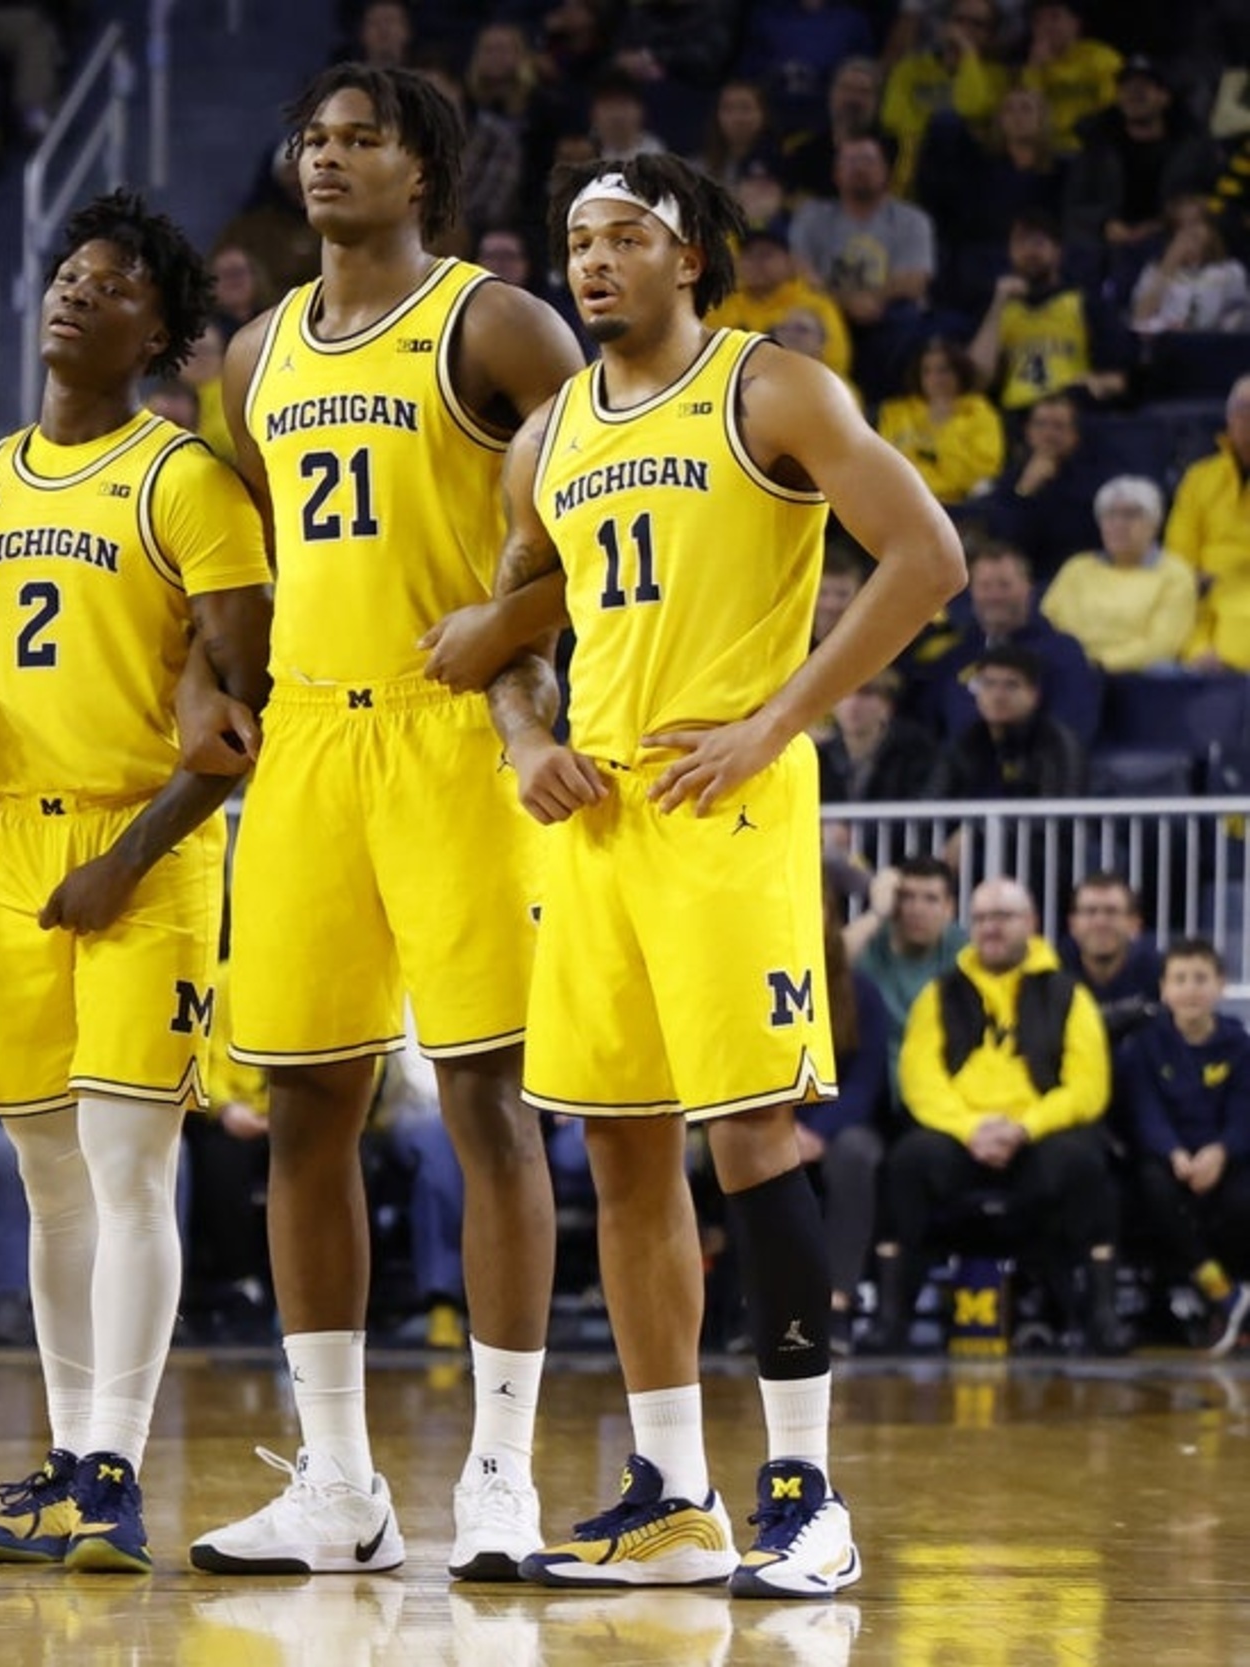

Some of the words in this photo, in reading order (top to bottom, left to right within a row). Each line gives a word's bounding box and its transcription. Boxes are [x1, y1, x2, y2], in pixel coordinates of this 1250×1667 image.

[267, 395, 418, 441] MICHIGAN
[301, 448, 378, 541] 21
[555, 457, 709, 518] MICHIGAN
[597, 513, 660, 608] 11
[17, 582, 60, 668] 2
[349, 689, 373, 709] M
[41, 798, 65, 815] M
[170, 980, 214, 1037] M
[768, 970, 812, 1026] M
[956, 1290, 997, 1325] M
[772, 1477, 802, 1499] M
